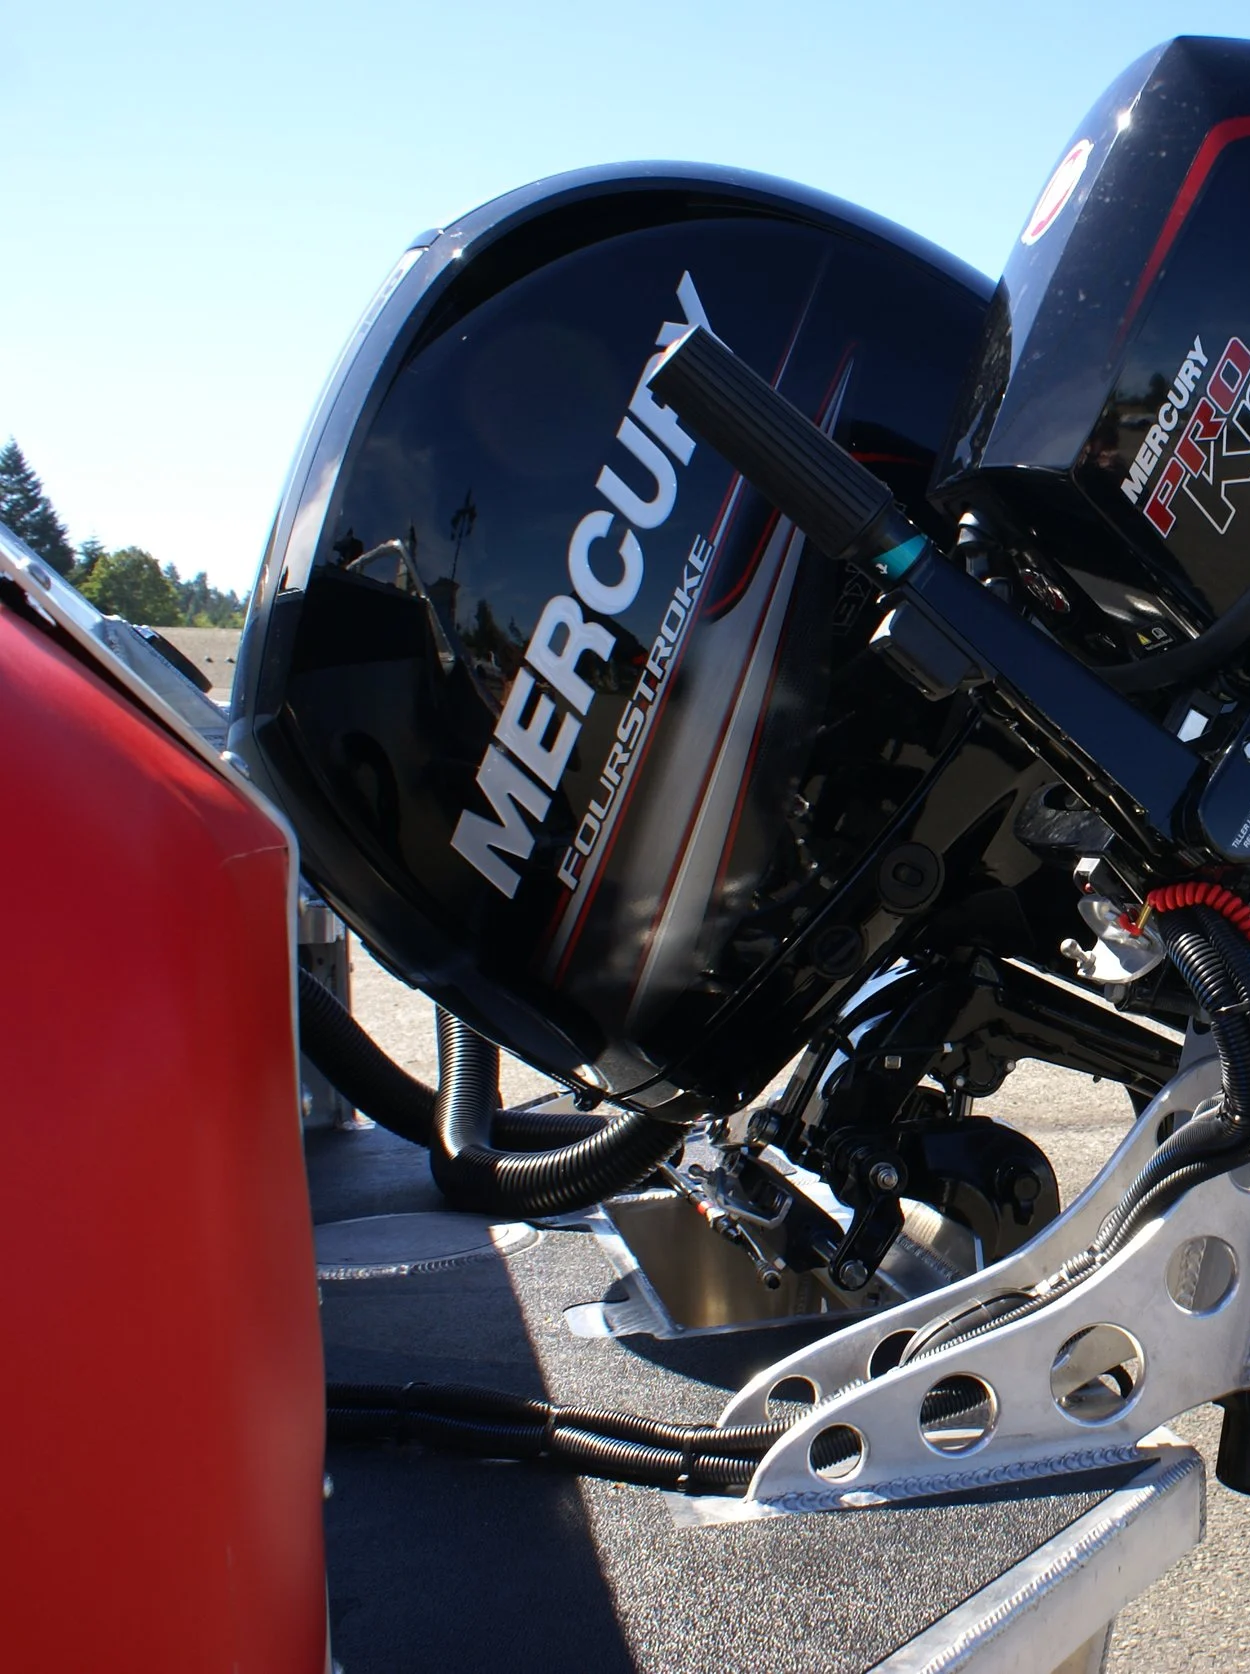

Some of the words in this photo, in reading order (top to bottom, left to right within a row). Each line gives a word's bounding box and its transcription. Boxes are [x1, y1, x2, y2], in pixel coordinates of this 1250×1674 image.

[1120, 335, 1209, 505] MERCURY
[557, 534, 713, 891] FOURSTROKE
[1231, 824, 1250, 849] TILLER
